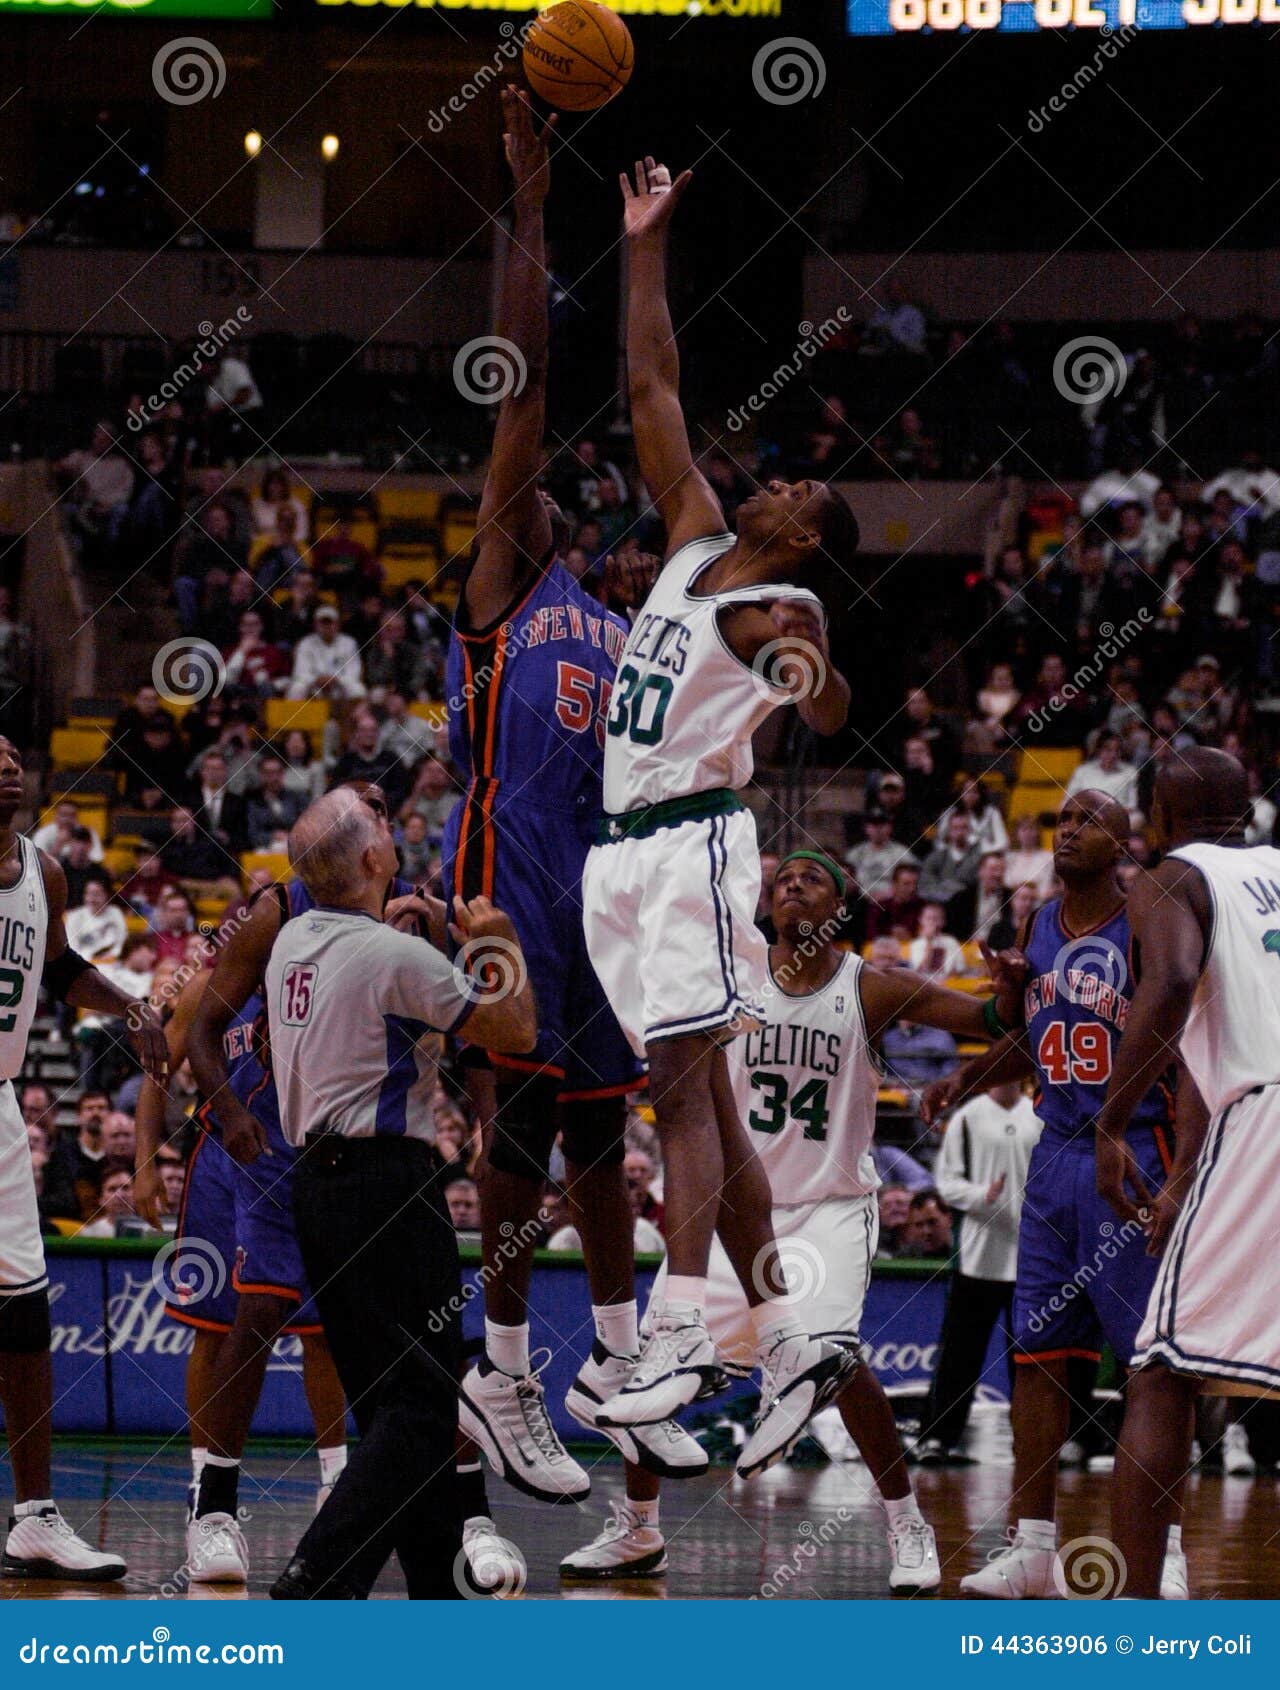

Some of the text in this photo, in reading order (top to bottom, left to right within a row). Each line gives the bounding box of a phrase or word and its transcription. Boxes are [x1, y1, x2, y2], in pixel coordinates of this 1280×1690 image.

[527, 604, 584, 649] NEW
[607, 663, 674, 746] 30
[285, 970, 314, 1021] 15
[745, 1023, 841, 1077] CELTICS
[1039, 1020, 1113, 1085] 49
[749, 1070, 830, 1141] 34
